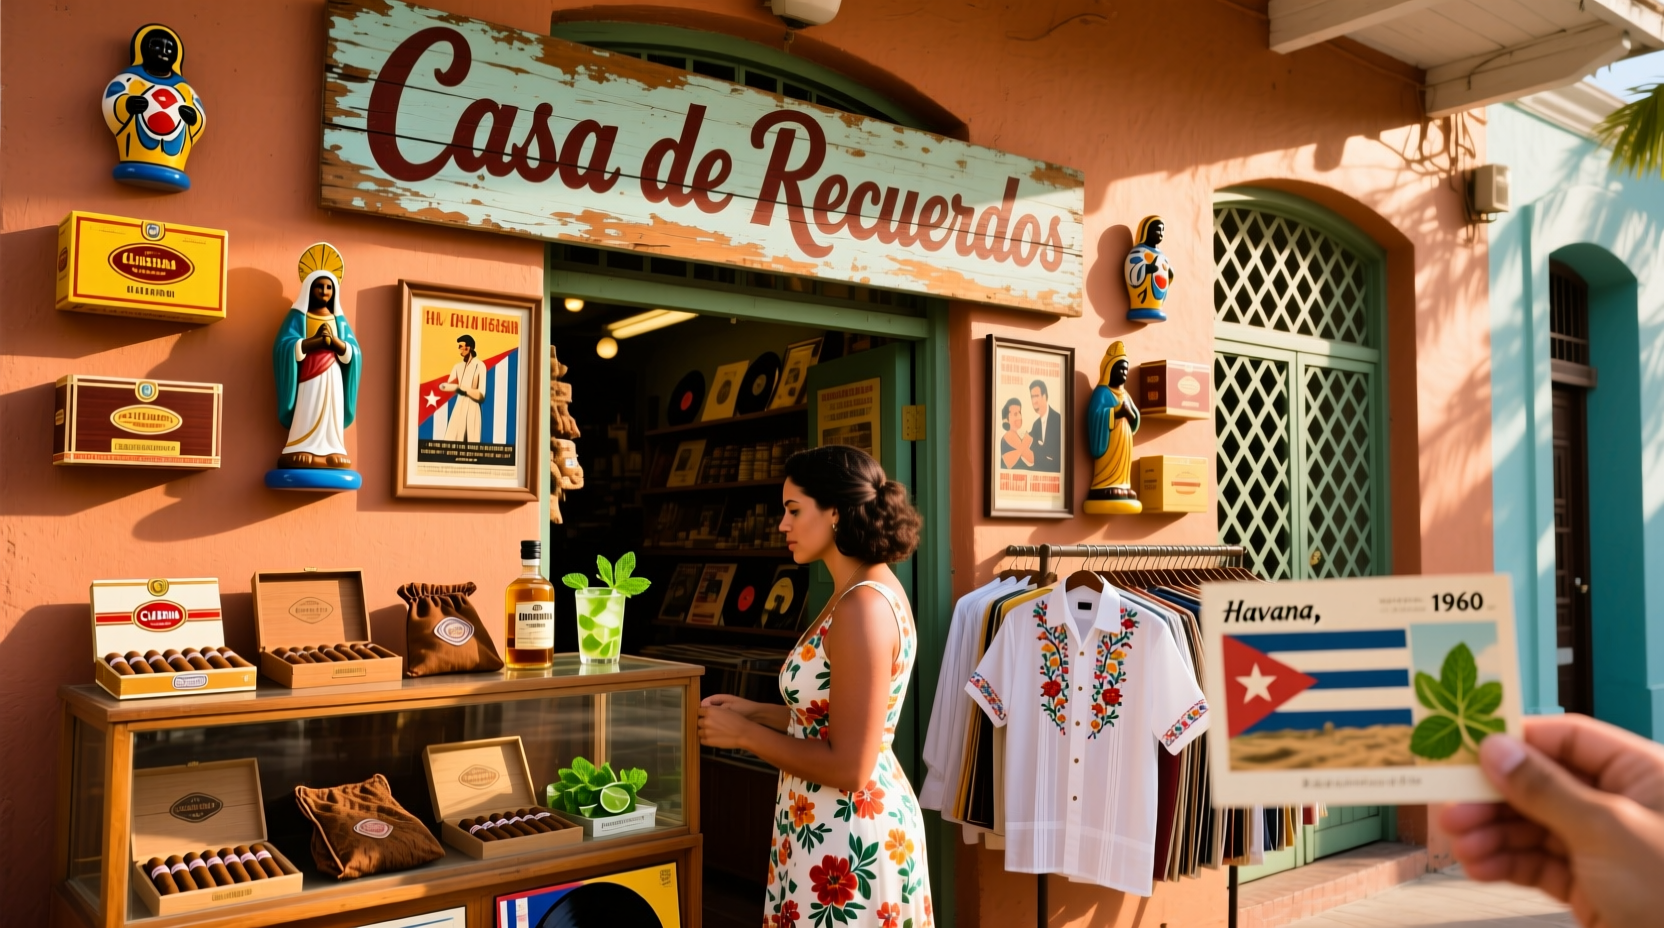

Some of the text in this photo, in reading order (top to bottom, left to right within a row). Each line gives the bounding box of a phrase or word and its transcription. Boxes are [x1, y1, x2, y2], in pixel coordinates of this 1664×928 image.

[367, 26, 1064, 273] Casa de Recuerdos
[1222, 599, 1321, 625] Havana,
[1431, 591, 1484, 612] 1960
